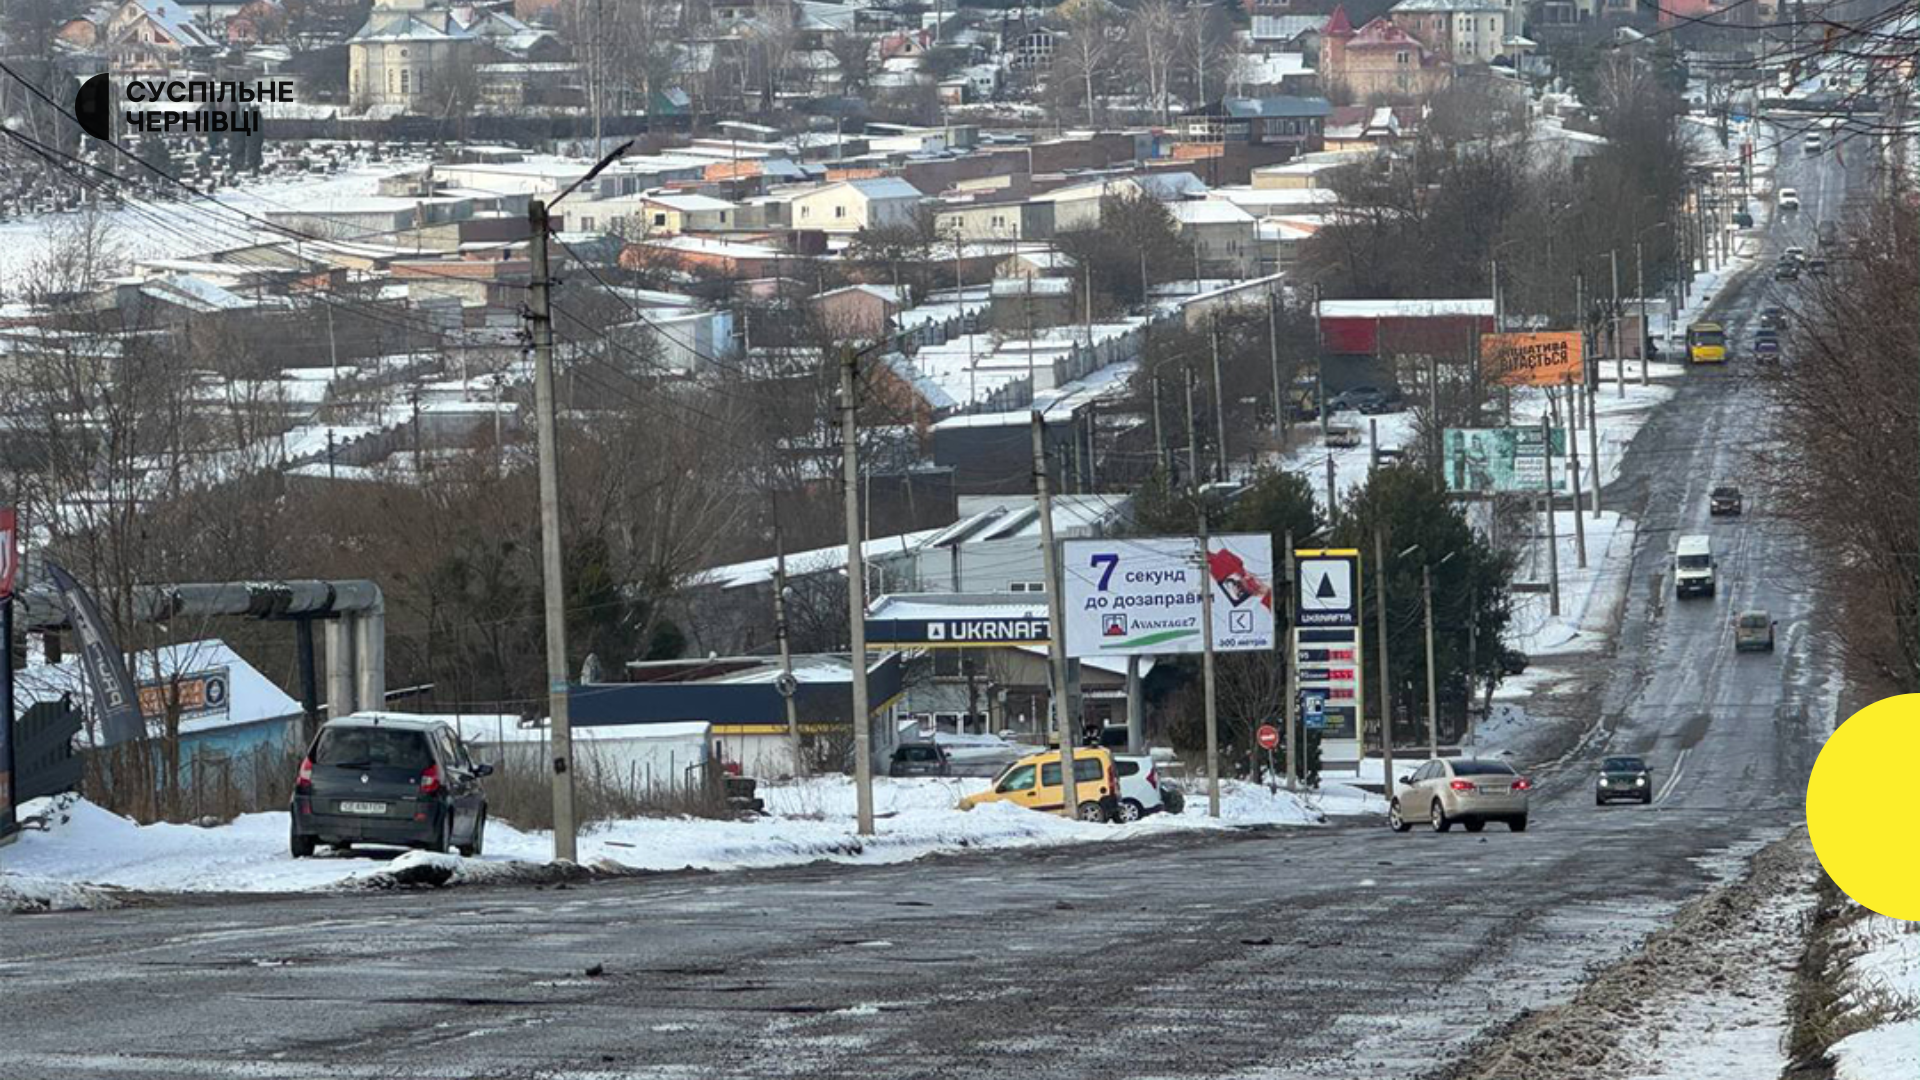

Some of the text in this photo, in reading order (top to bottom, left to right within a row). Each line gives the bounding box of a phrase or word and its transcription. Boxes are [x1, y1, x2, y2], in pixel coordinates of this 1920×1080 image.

[1090, 554, 1186, 591] 7 секунд
[1085, 592, 1215, 609] до дозаправки
[952, 621, 1051, 640] UKRNAFT
